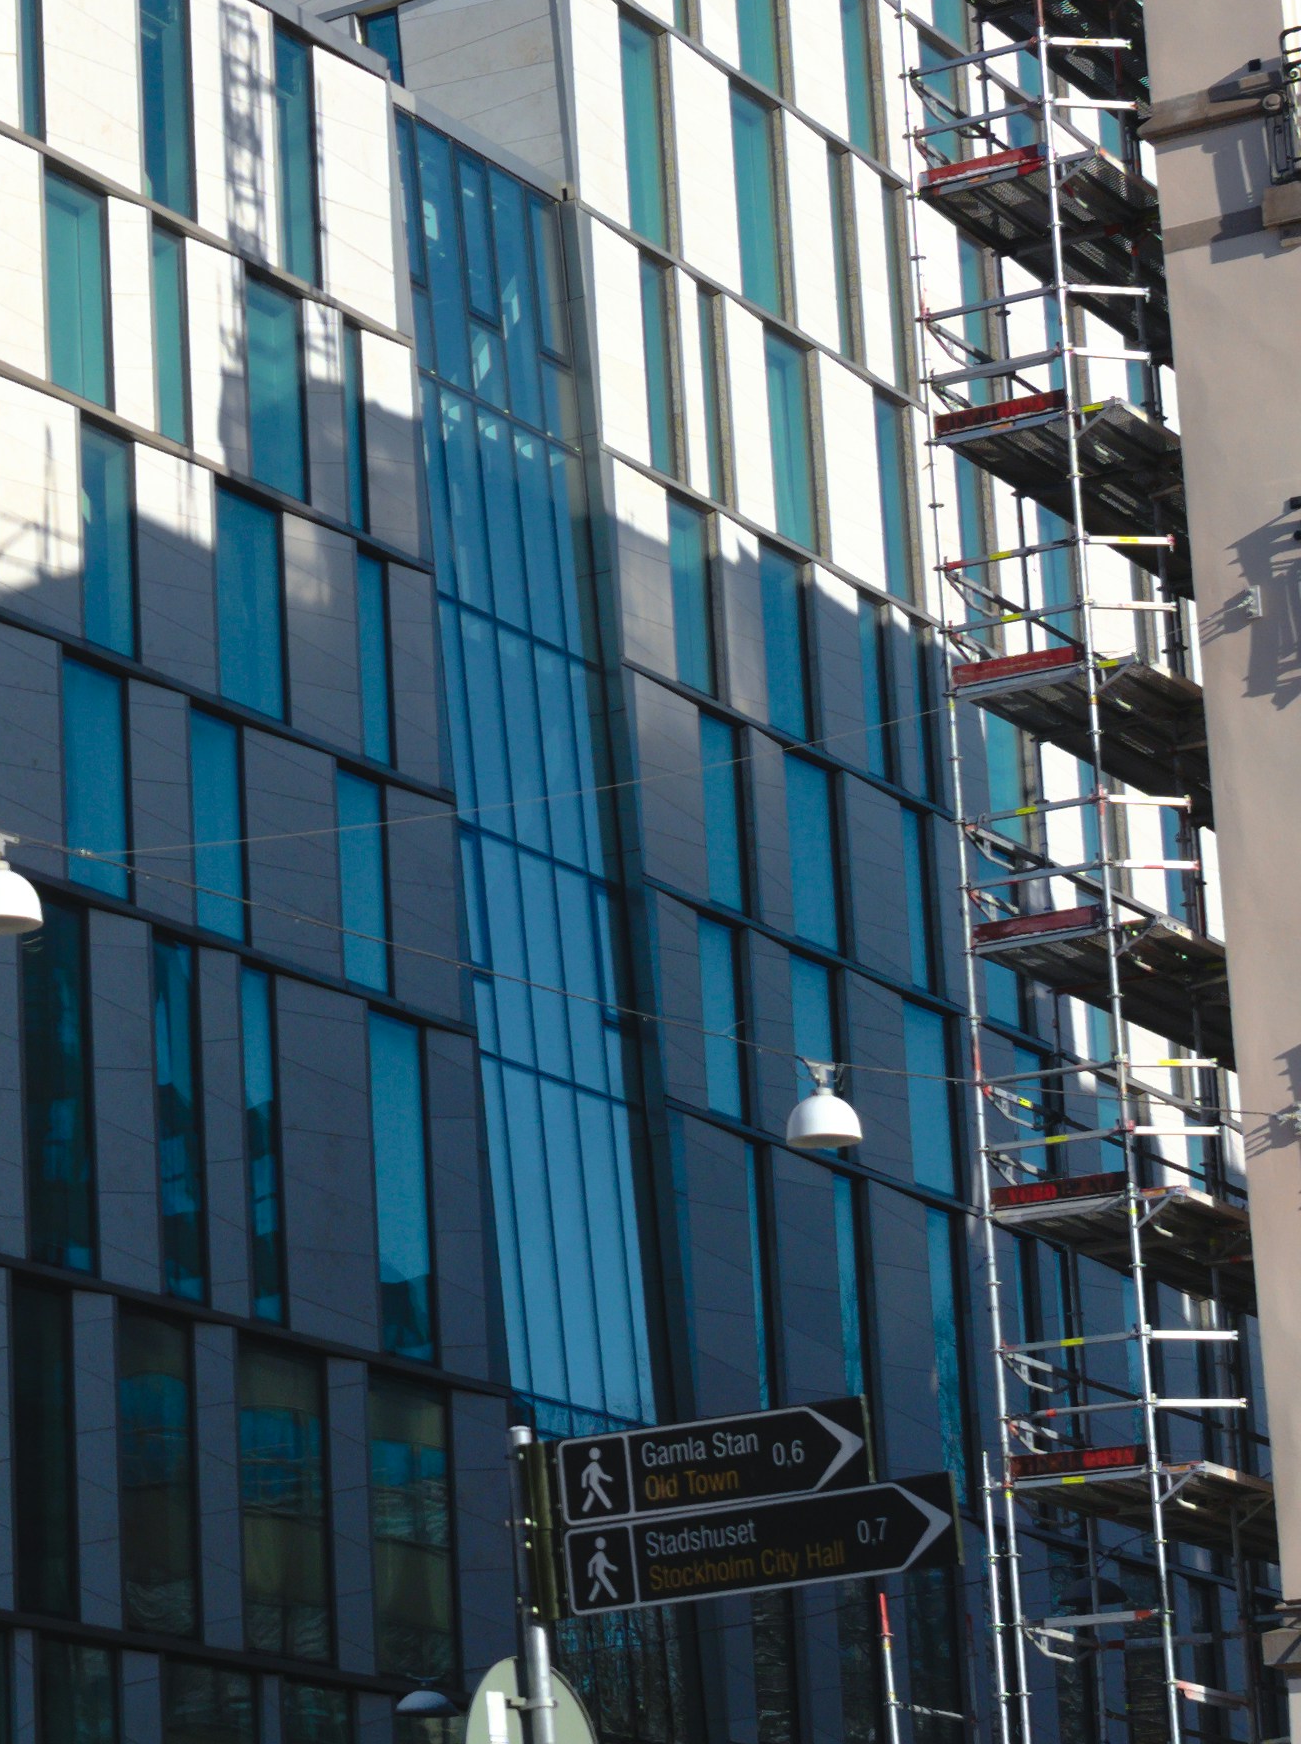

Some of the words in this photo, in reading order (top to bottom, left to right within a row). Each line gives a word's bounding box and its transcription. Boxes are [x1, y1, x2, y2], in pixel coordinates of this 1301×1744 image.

[641, 1436, 707, 1468] Gamla
[712, 1431, 760, 1458] Stan
[644, 1473, 679, 1501] Old
[684, 1469, 740, 1496] Town
[645, 1518, 757, 1558] Stadshuset
[649, 1555, 756, 1592] Stockholm
[760, 1547, 799, 1578] City
[805, 1539, 846, 1569] Hall
